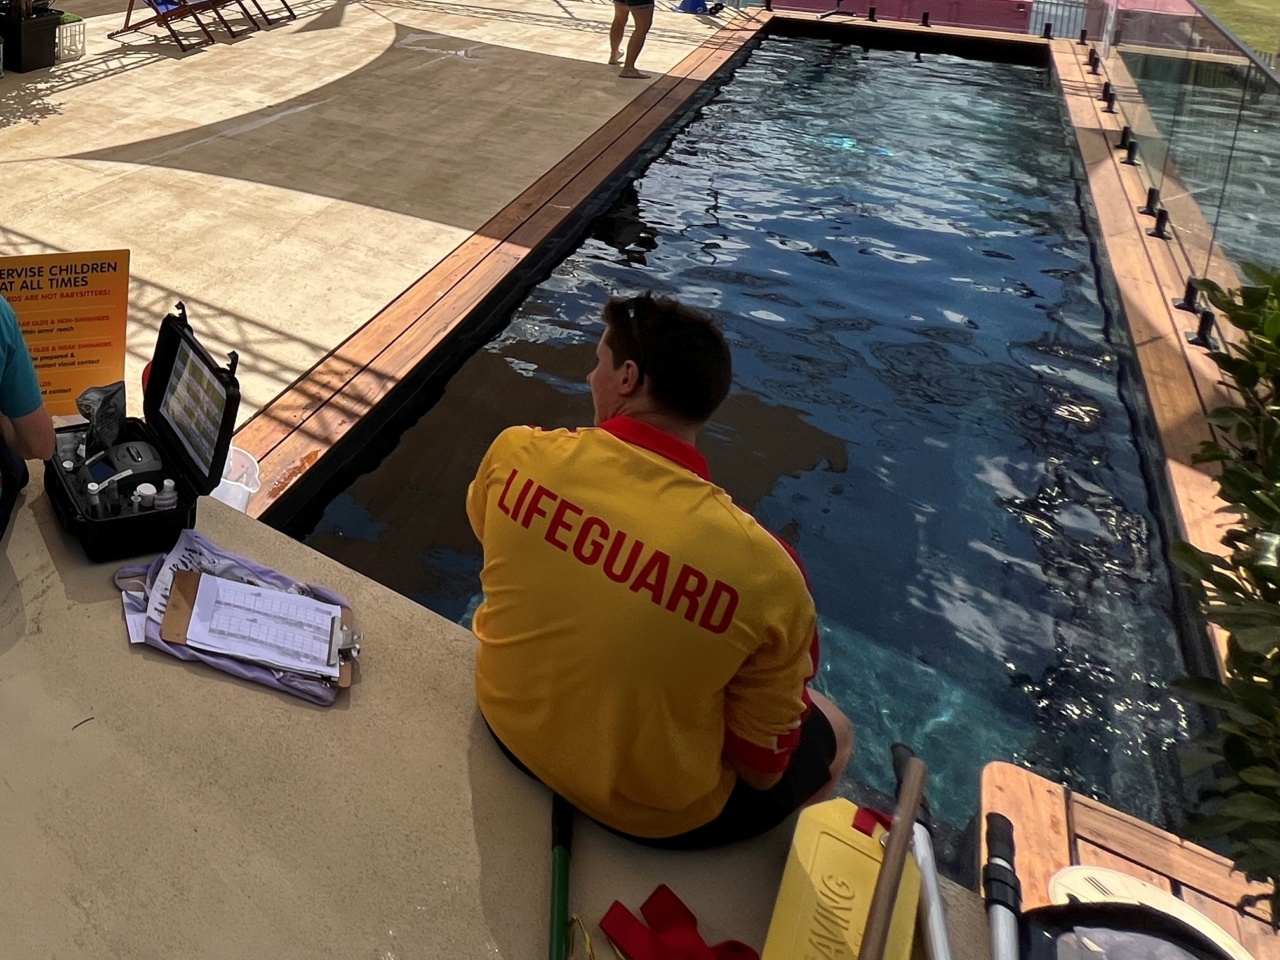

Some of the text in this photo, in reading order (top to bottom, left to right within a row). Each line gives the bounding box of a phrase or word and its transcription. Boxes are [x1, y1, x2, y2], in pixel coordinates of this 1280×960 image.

[49, 261, 117, 276] CHILDREN
[0, 275, 89, 293] AT ALL TIMES
[24, 293, 39, 302] ARE
[41, 292, 57, 300] NOT
[60, 289, 111, 299] BABYSITTERS!
[32, 319, 49, 327] OLDS
[58, 343, 76, 351] WEAK
[497, 468, 740, 634] LIFEGUARD
